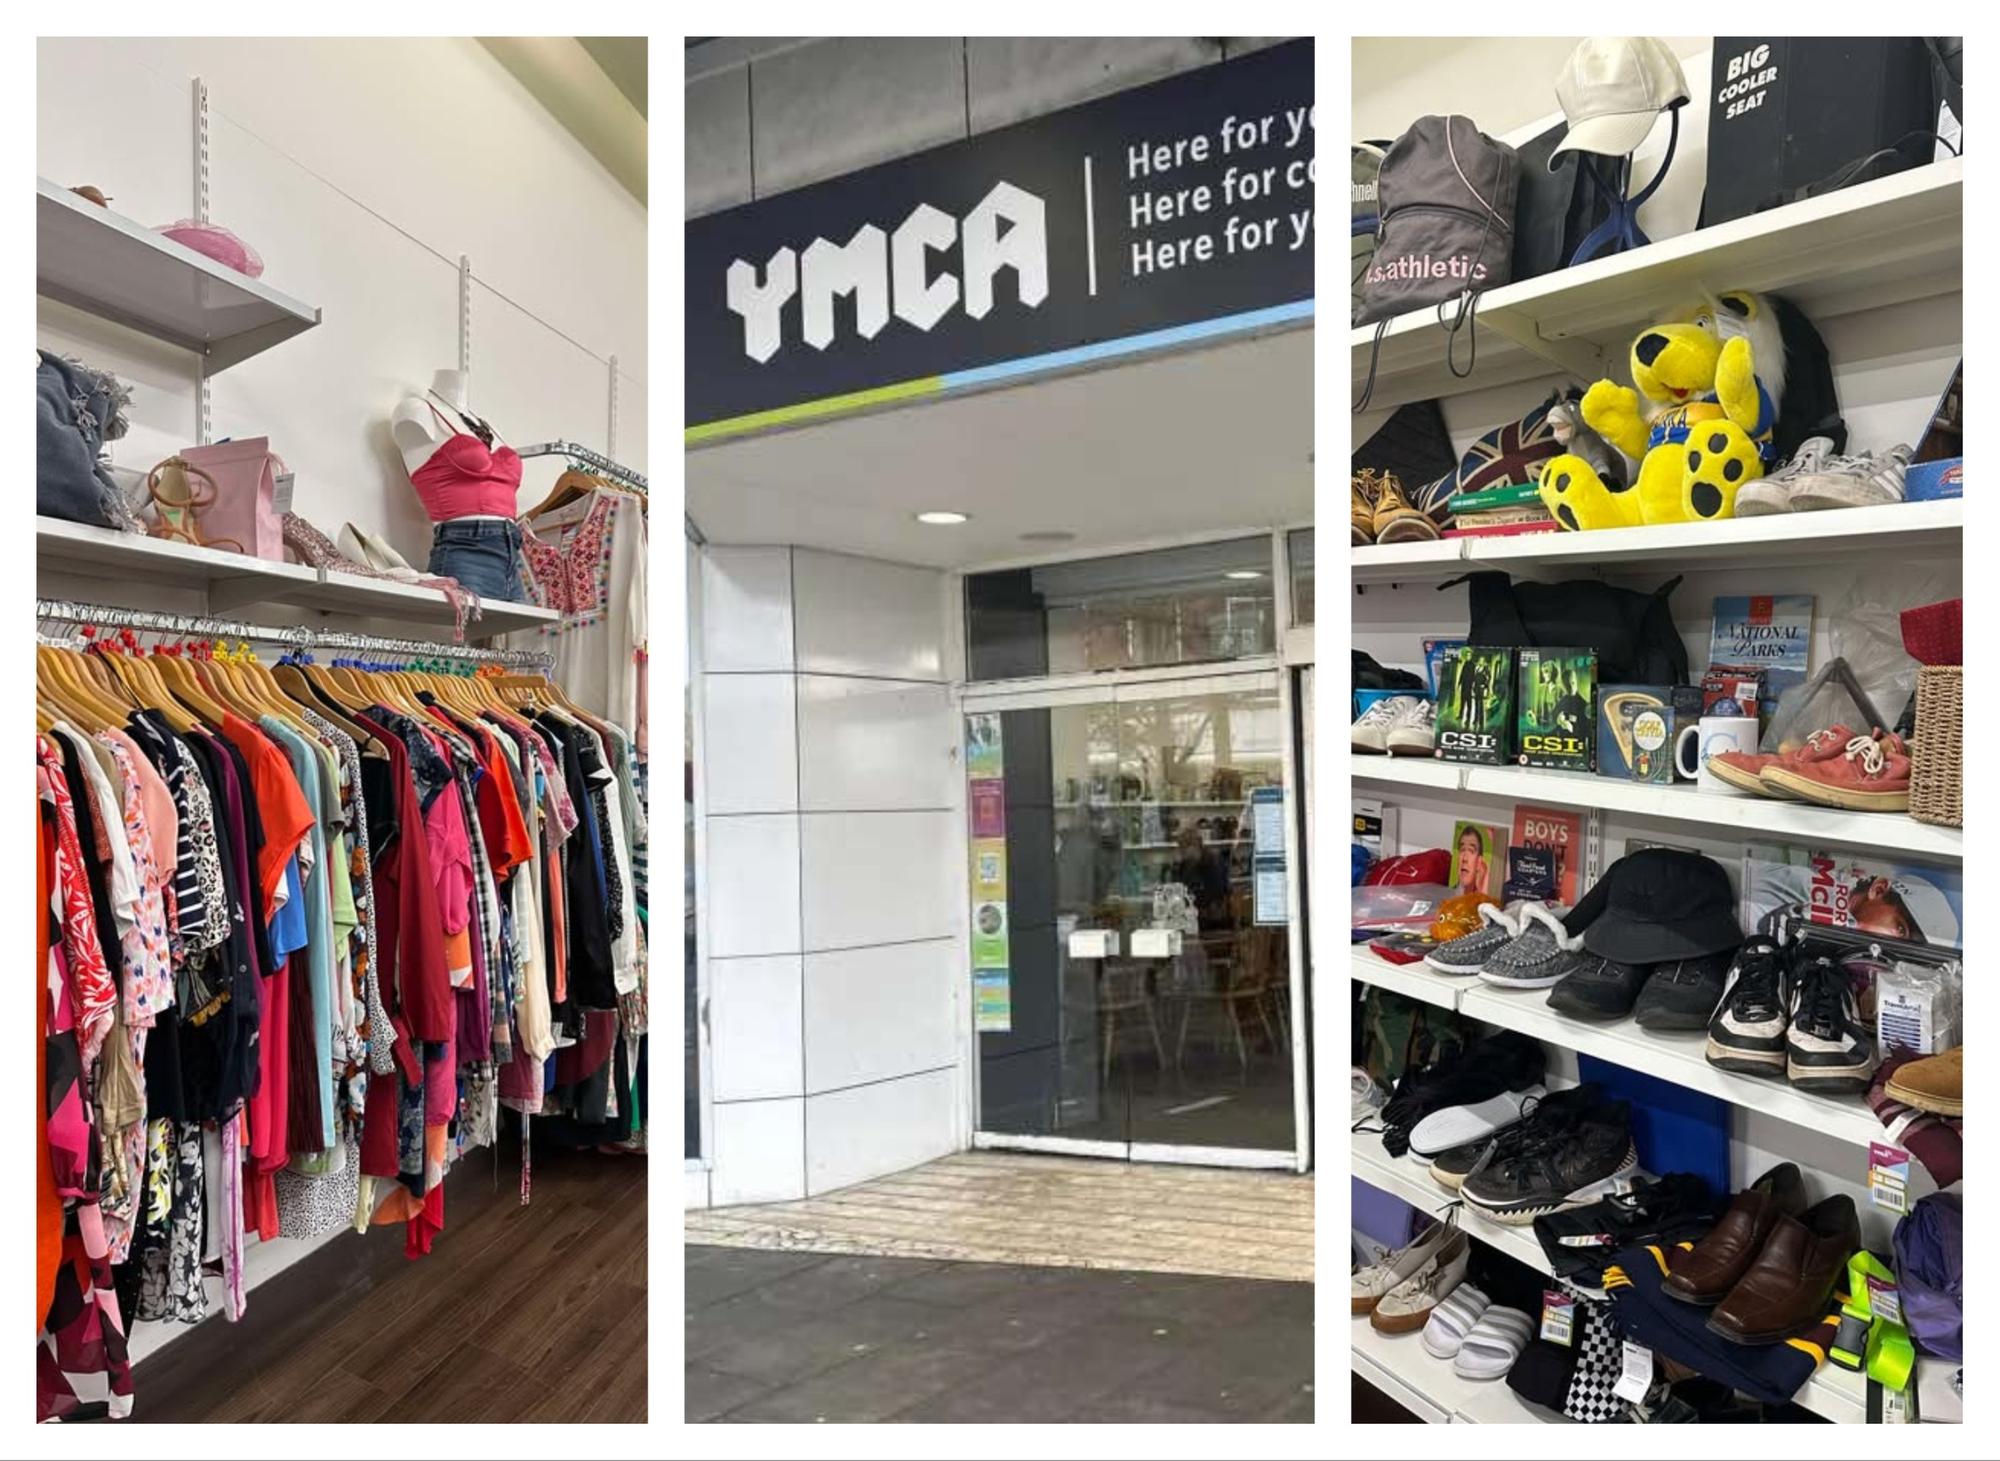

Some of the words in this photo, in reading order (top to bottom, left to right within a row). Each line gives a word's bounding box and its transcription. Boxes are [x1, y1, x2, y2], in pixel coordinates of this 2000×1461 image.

[1726, 44, 1770, 82] BIG
[1718, 66, 1778, 104] COOLER
[1726, 90, 1767, 119] SEAT
[1128, 135, 1209, 180] Here
[1220, 115, 1274, 154] for
[1129, 185, 1211, 229] Here
[1221, 167, 1276, 205] for
[1132, 234, 1214, 277] Here
[1224, 216, 1279, 253] for
[1289, 209, 1315, 251] y
[726, 181, 1049, 365] YMCA
[1719, 622, 1799, 640] NATIONAL
[1729, 639, 1787, 657] PARKS
[1441, 731, 1497, 749] CSI:
[1523, 735, 1584, 753] CSI:
[1524, 820, 1569, 843] BOYS
